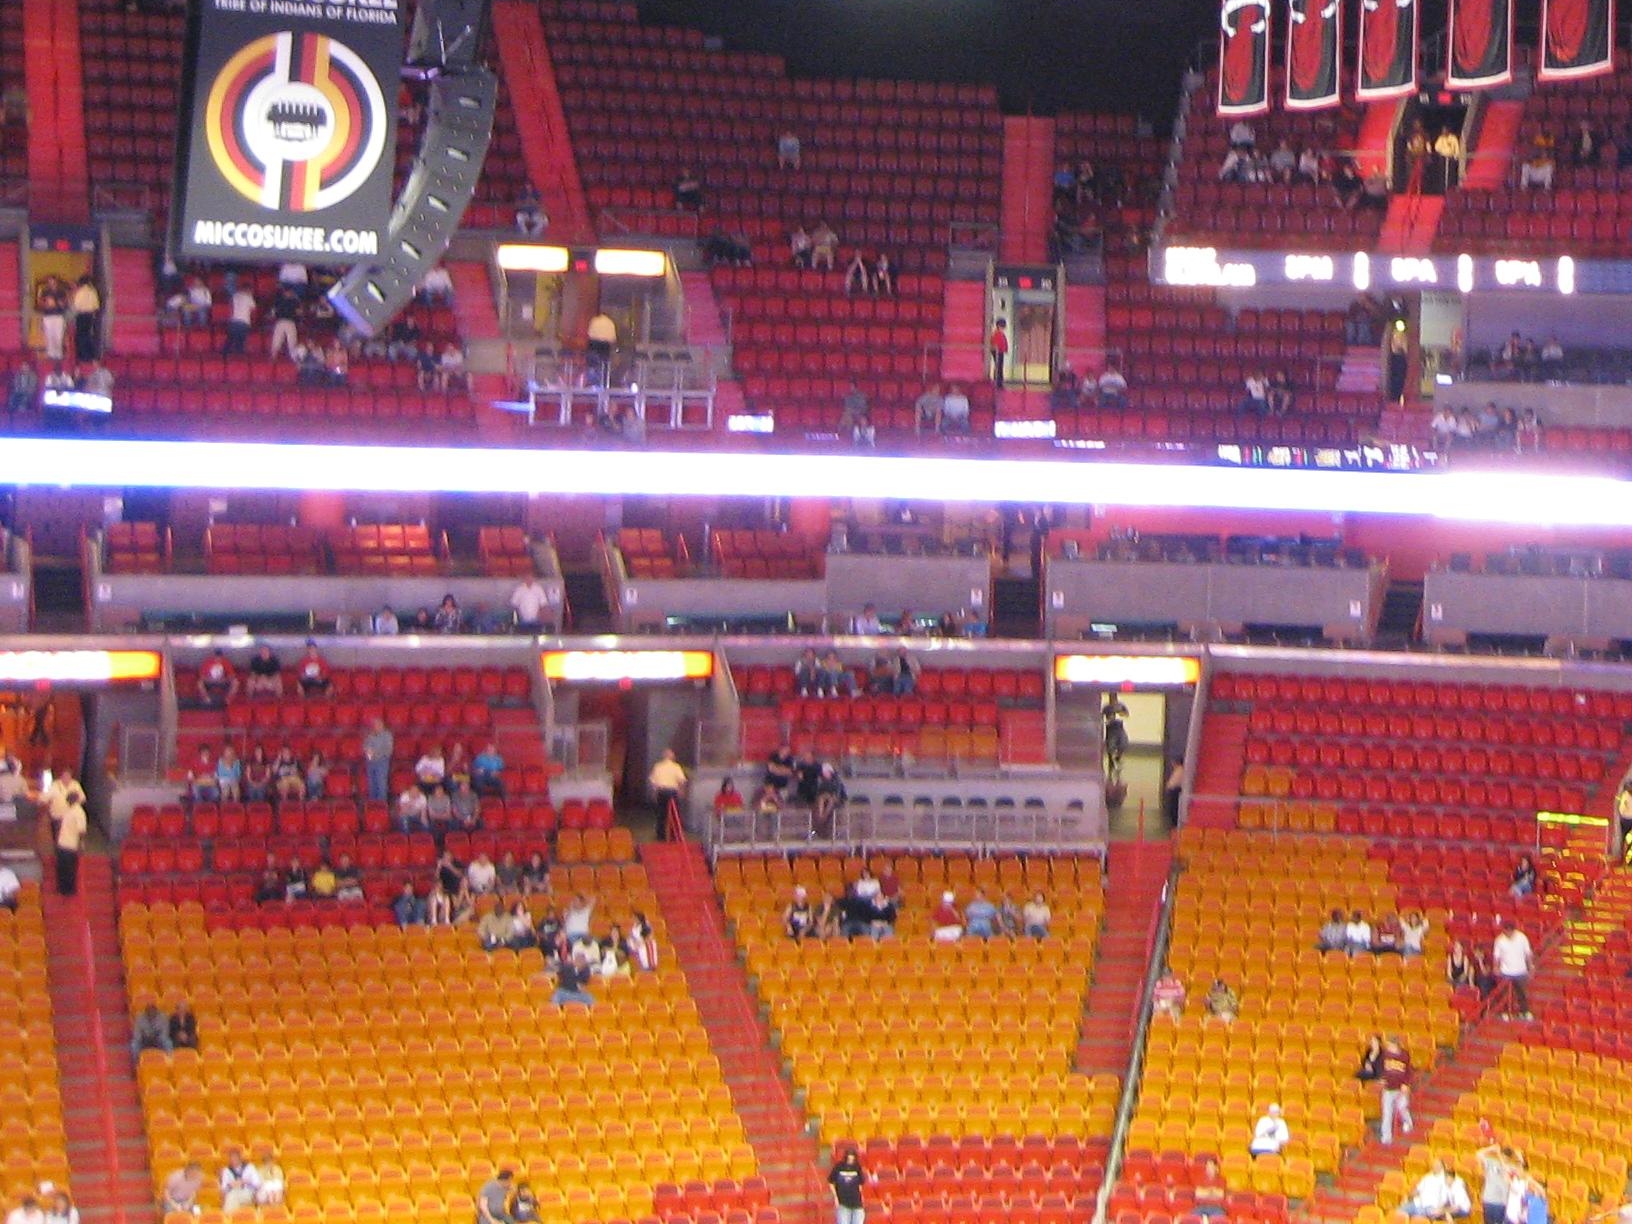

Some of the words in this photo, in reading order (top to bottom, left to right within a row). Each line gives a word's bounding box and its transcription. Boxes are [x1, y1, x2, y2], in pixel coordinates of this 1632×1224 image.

[270, 0, 323, 19] INDIANS
[326, 5, 344, 20] OF
[346, 8, 398, 24] FLORIDA
[194, 219, 378, 255] MICCOSUKEE.COM
